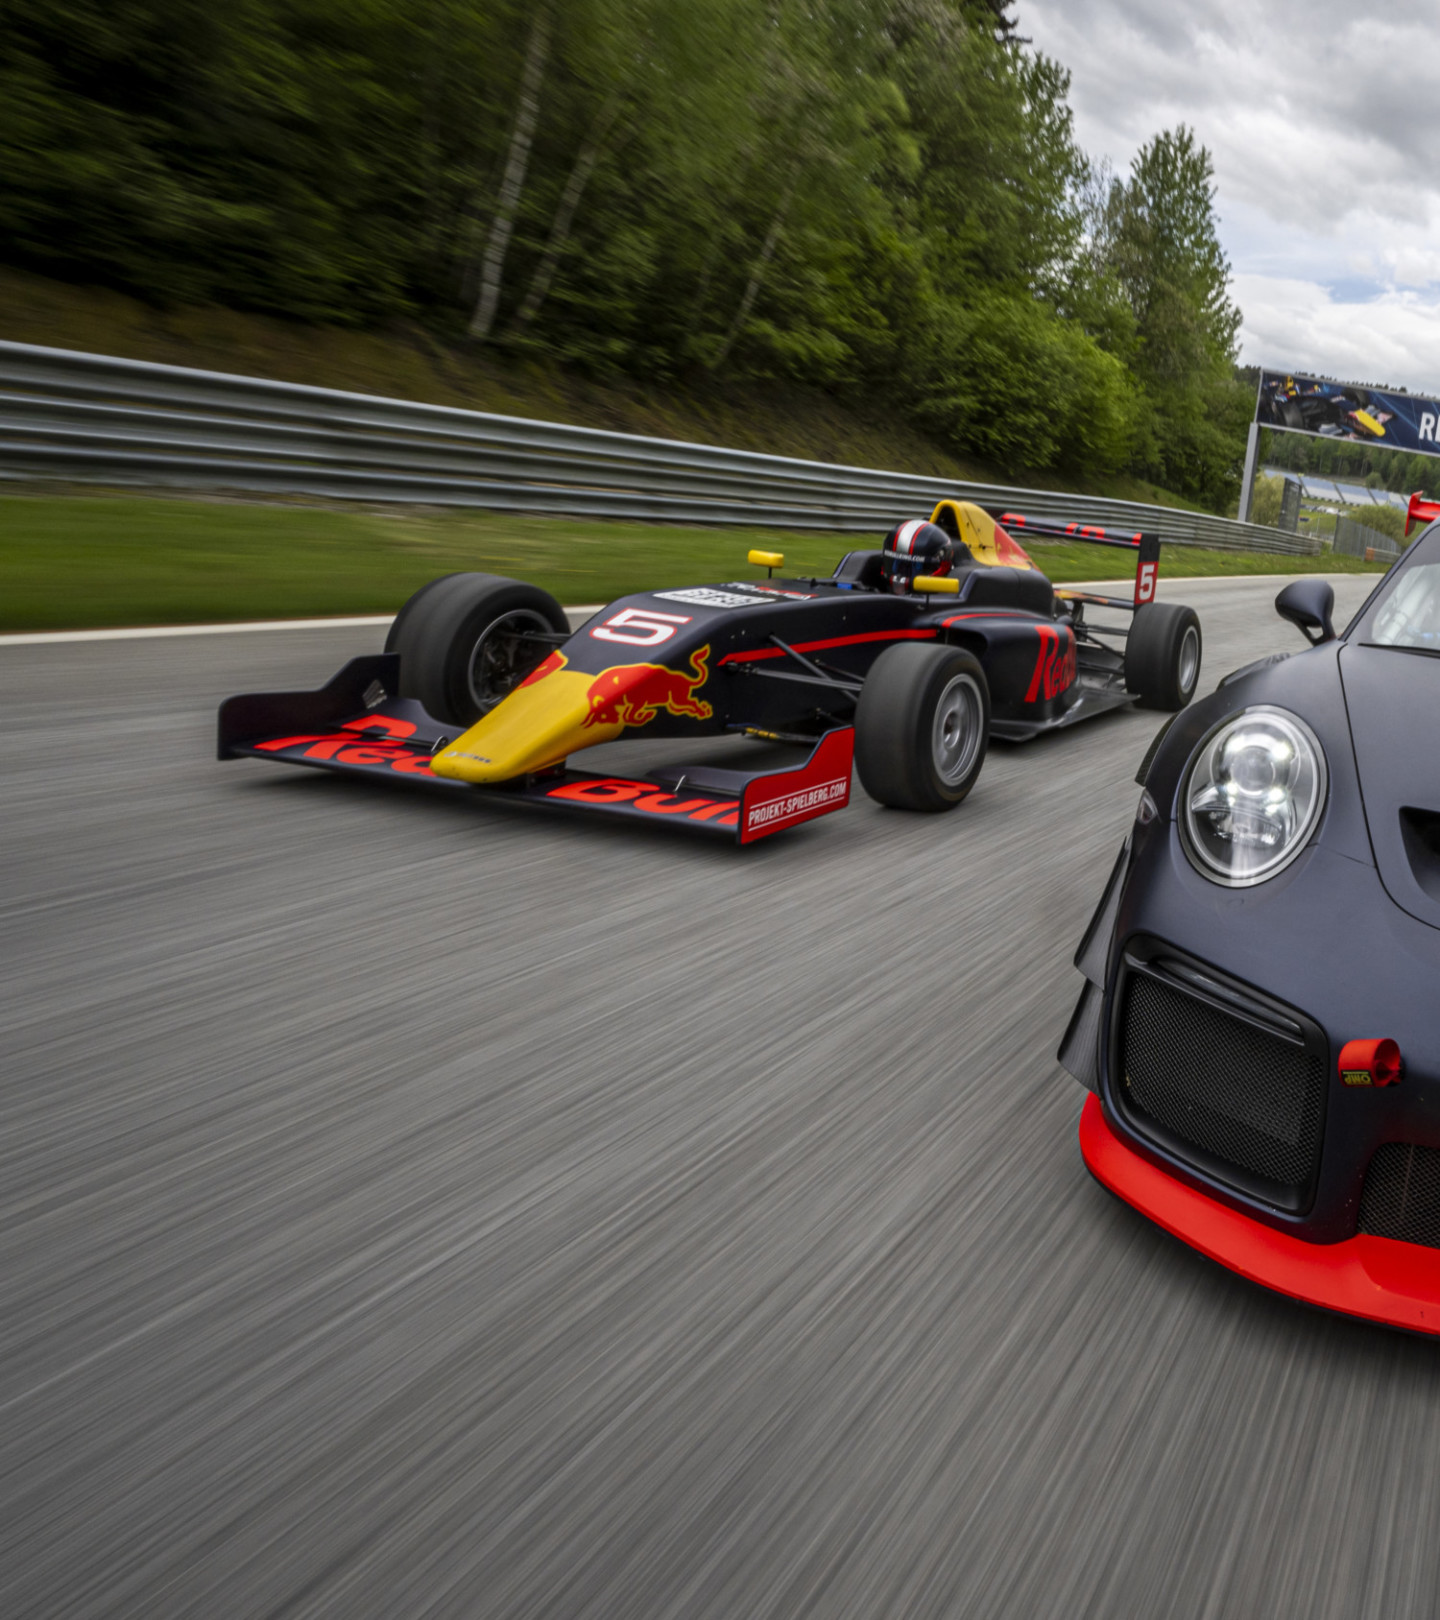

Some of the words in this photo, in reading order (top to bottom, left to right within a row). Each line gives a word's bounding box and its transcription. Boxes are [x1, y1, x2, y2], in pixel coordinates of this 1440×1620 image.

[1139, 564, 1155, 601] 5
[589, 607, 693, 647] 5
[748, 781, 848, 826] PROJEKT-SPIELBERG.COM
